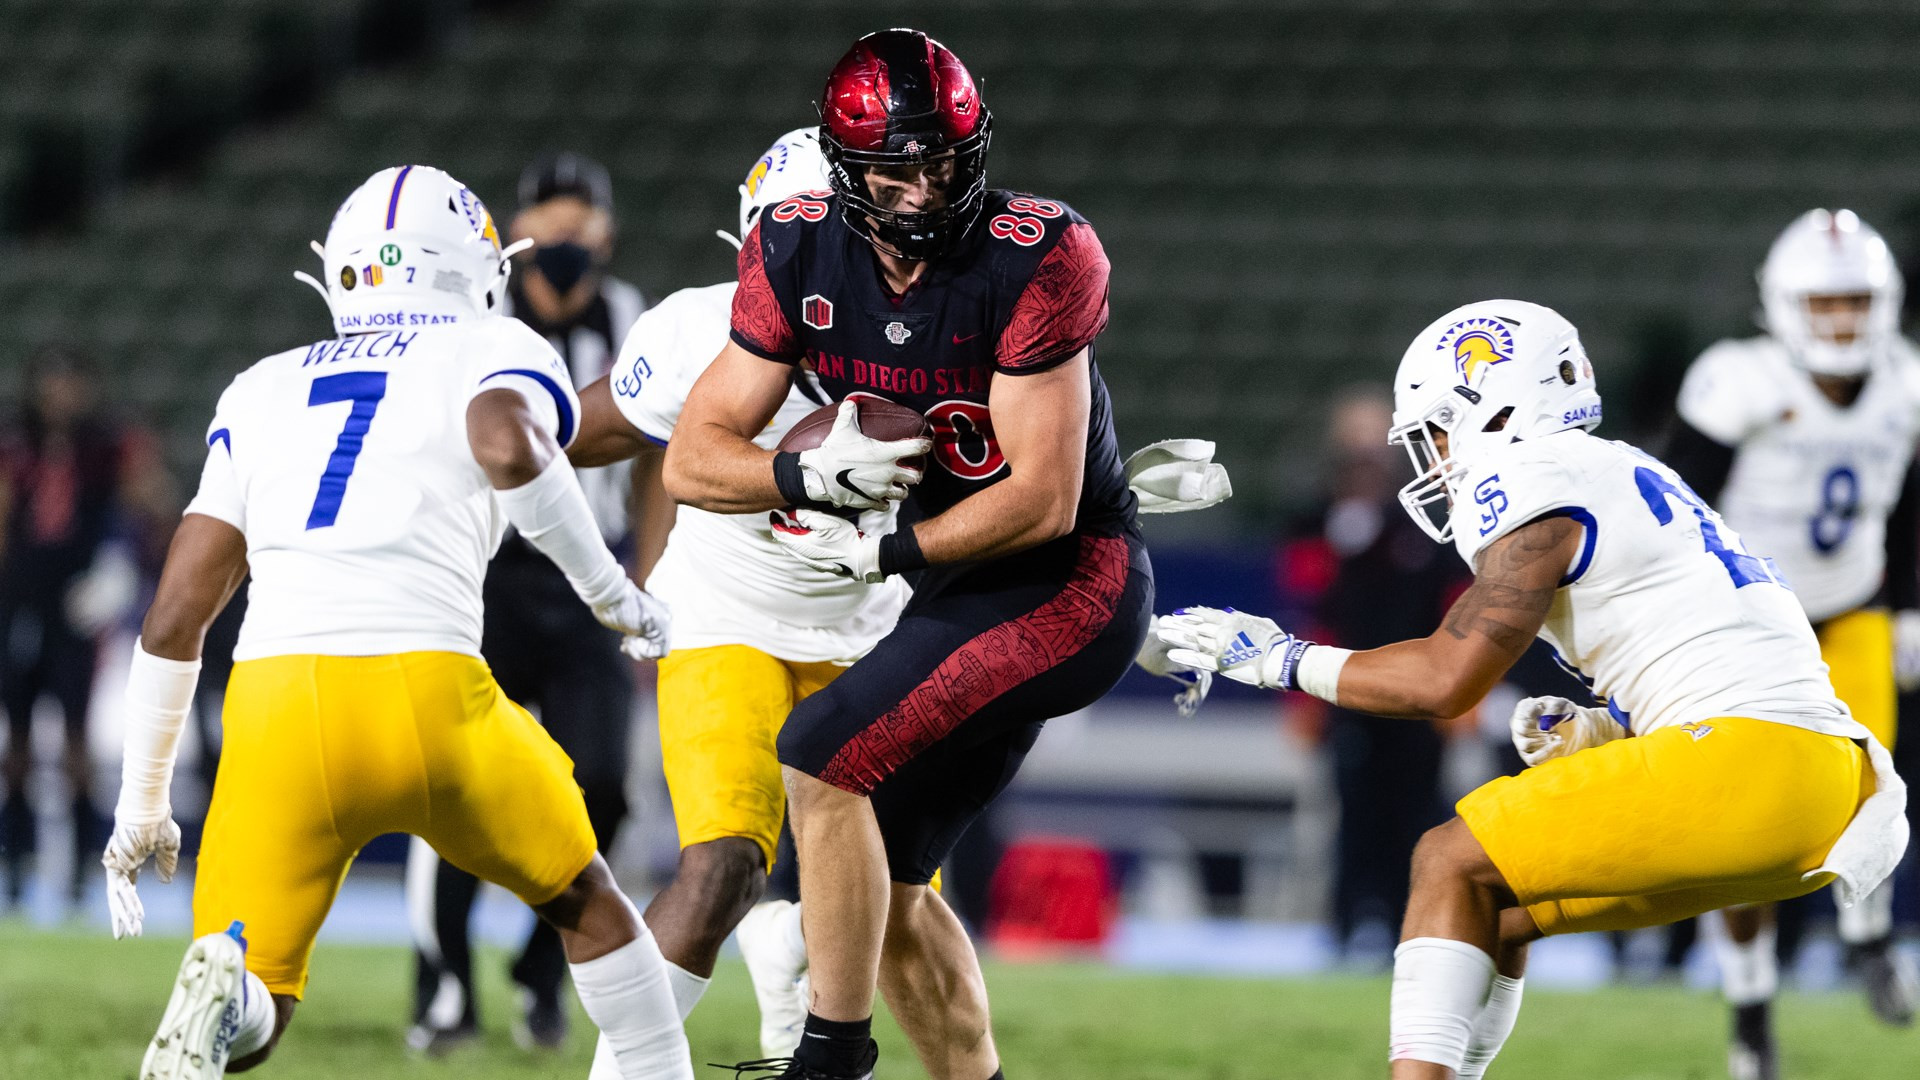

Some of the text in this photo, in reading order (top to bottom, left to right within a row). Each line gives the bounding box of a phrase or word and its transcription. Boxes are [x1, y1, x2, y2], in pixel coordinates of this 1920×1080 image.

[989, 198, 1064, 246] 88
[381, 245, 401, 266] H
[405, 266, 416, 283] 7
[340, 314, 361, 327] SAN
[410, 313, 458, 325] STATE
[302, 331, 418, 367] WELCH
[806, 347, 846, 381] SAN
[853, 359, 928, 394] DIEGO
[1563, 406, 1587, 424] SAN
[306, 371, 389, 531] 7
[1221, 647, 1262, 667] adidas
